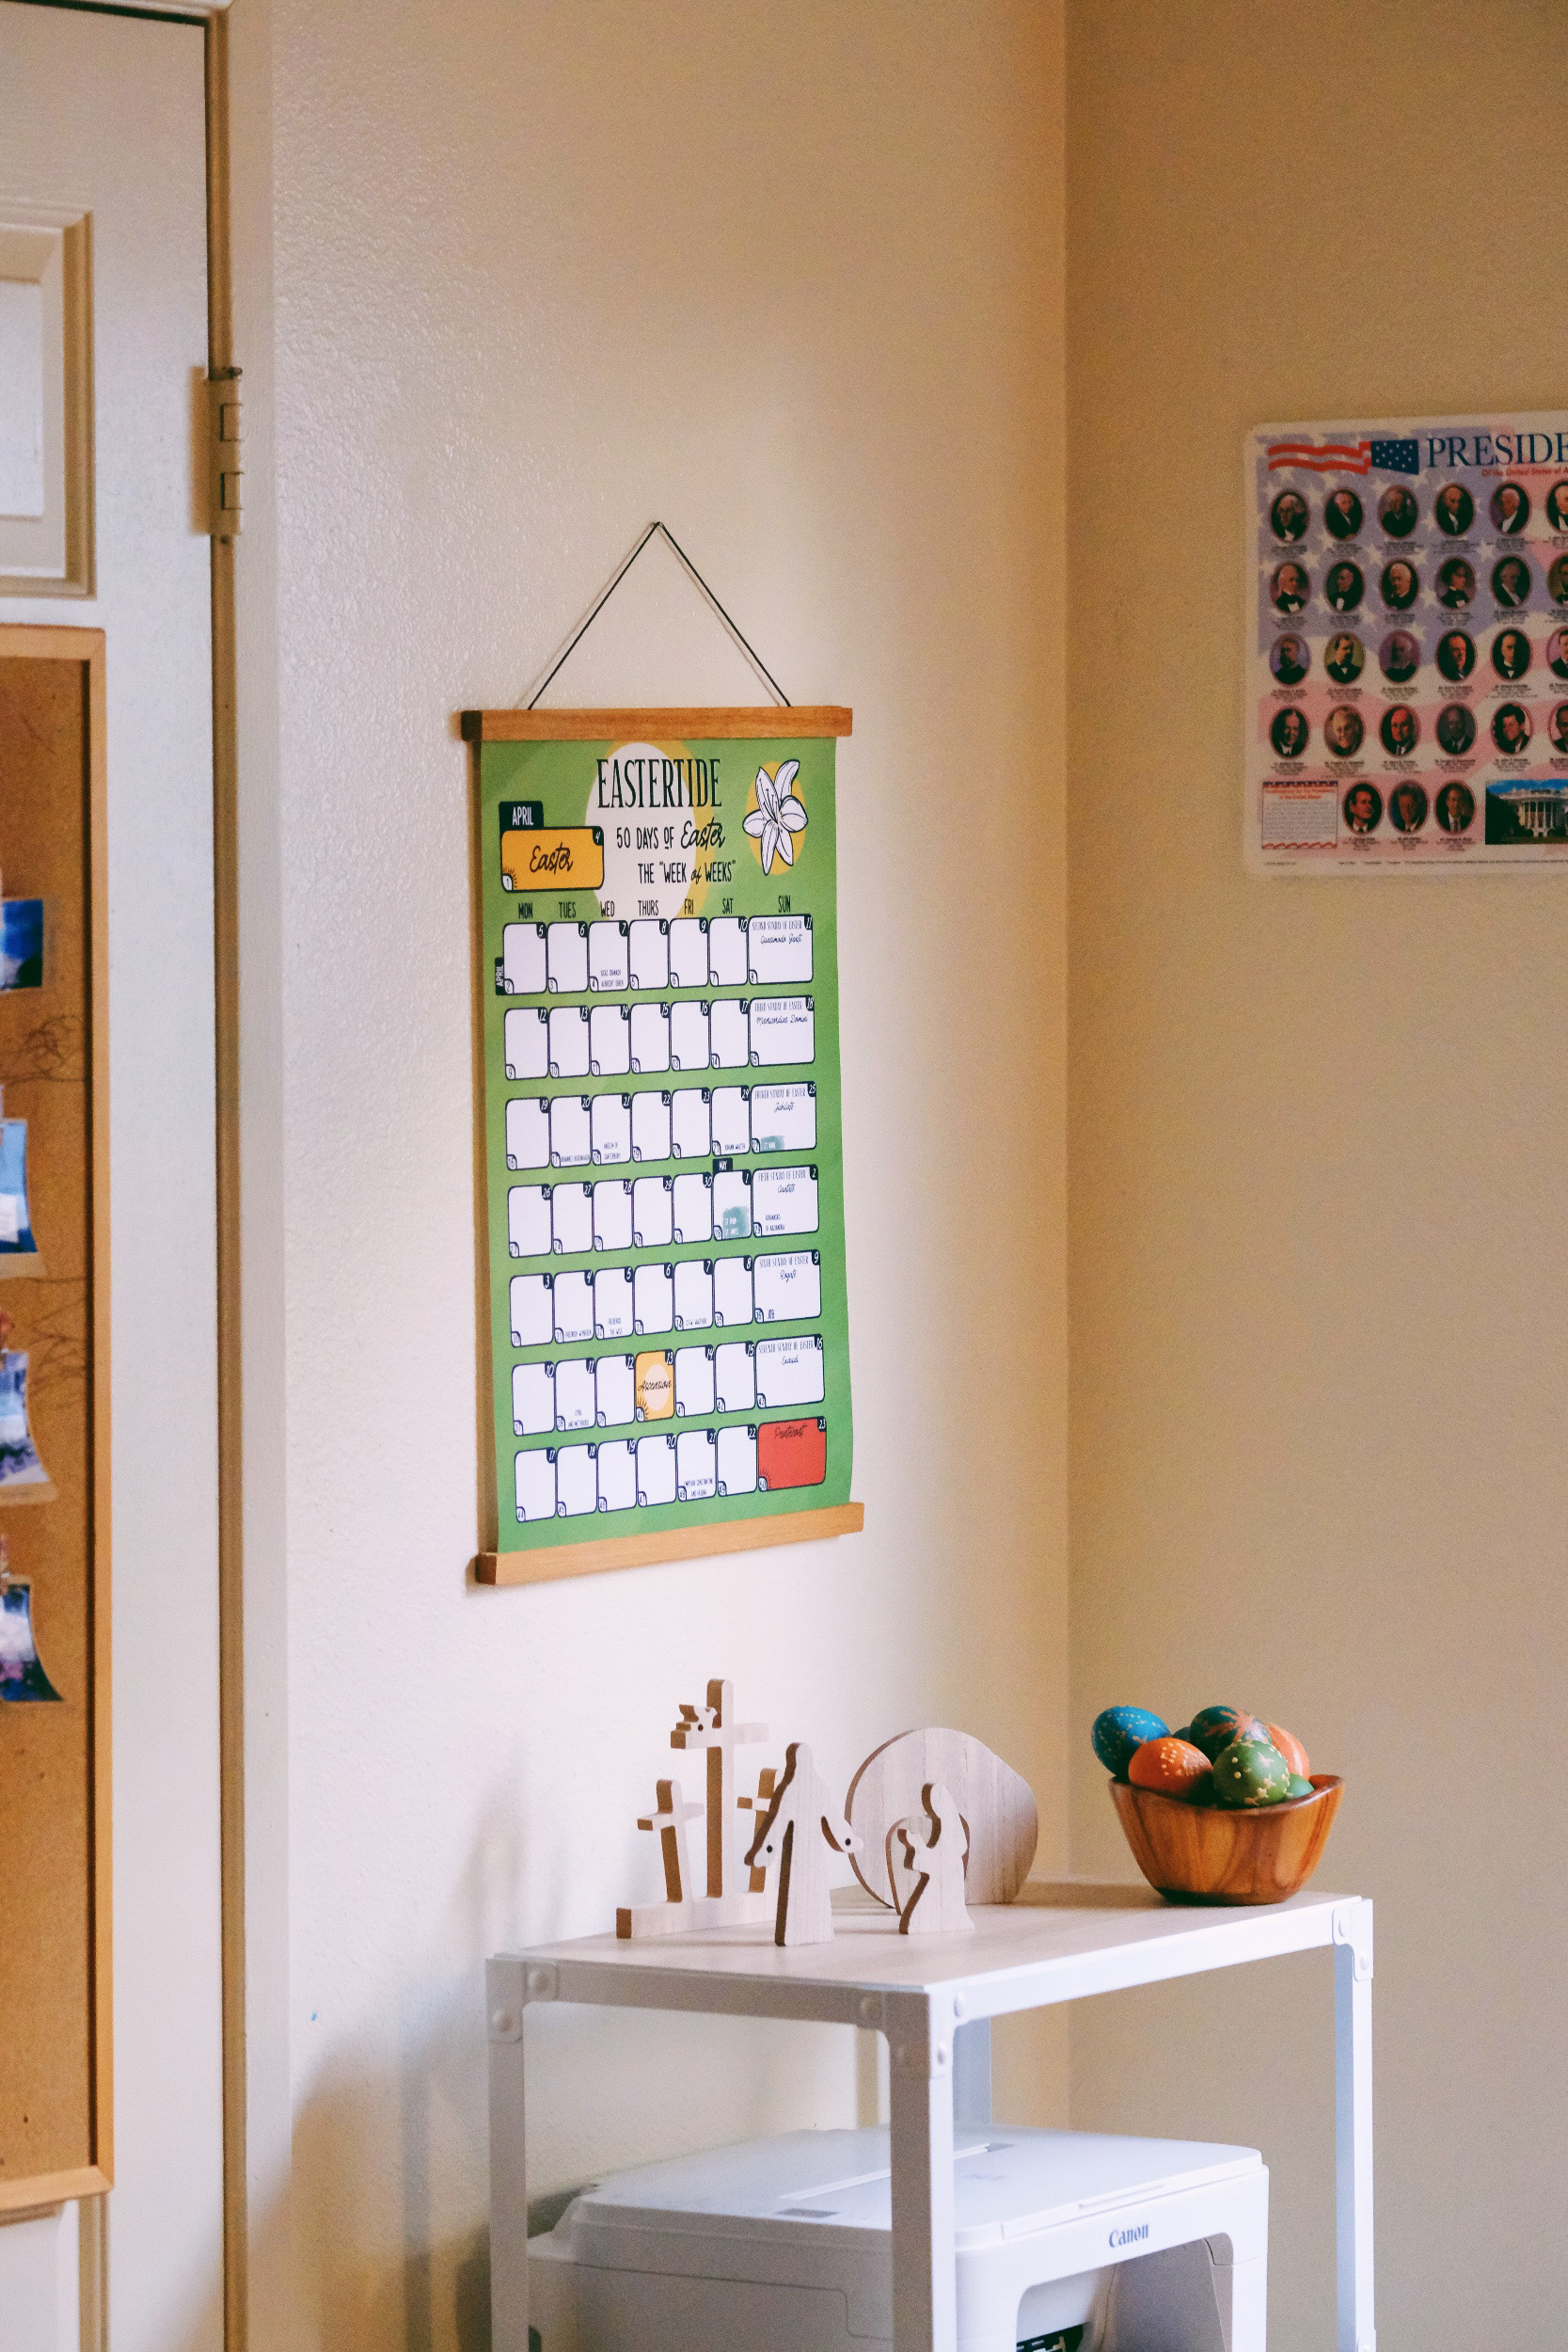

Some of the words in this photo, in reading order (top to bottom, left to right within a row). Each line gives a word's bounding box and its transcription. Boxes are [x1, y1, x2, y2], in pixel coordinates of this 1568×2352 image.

[596, 758, 722, 808] EASTERTIDE
[512, 806, 534, 826] APRIL
[595, 832, 600, 842] 4
[616, 826, 631, 849] 50
[636, 826, 659, 850] DAYS
[680, 817, 726, 851] Easter
[529, 842, 574, 875] Easter
[638, 863, 655, 883] THE
[690, 866, 703, 885] of
[517, 902, 533, 919] MON
[559, 901, 577, 918] TUES
[599, 900, 615, 917] WED
[638, 899, 659, 916] THURS
[684, 898, 694, 914] FRI
[722, 898, 734, 914] SAT
[778, 896, 791, 913] SUN
[622, 923, 626, 934] 7
[661, 921, 666, 933] 8
[702, 920, 705, 932] 9
[740, 918, 747, 931] 10
[806, 917, 813, 930] 11
[539, 925, 543, 937] 5
[580, 924, 584, 936] 6
[702, 1001, 707, 1014] 16
[741, 1001, 748, 1012] 17
[807, 997, 814, 1009] 18
[540, 1009, 546, 1022] 12
[581, 1008, 588, 1020] 13
[621, 1005, 628, 1018] 14
[662, 1004, 668, 1016] 15
[742, 1087, 749, 1099] 24
[809, 1084, 816, 1094] 25
[624, 1094, 630, 1106] 21
[663, 1093, 670, 1104] 22
[704, 1090, 709, 1102] 23
[542, 1100, 547, 1110] 19
[582, 1097, 590, 1108] 20
[719, 1160, 728, 1171] MAY
[745, 1173, 749, 1183] 1
[812, 1168, 816, 1177] 2
[624, 1180, 632, 1192] 28
[665, 1179, 672, 1190] 29
[705, 1176, 712, 1187] 30
[543, 1186, 550, 1198] 26
[584, 1184, 591, 1196] 27
[747, 1257, 752, 1268] 8
[815, 1252, 818, 1263] 9
[626, 1267, 631, 1279] 5
[666, 1264, 671, 1276] 6
[706, 1261, 710, 1273] 7
[546, 1276, 549, 1288] 3
[587, 1271, 592, 1283] 4
[816, 1338, 822, 1349] 16
[707, 1348, 714, 1359] 14
[748, 1344, 753, 1356] 15
[627, 1357, 633, 1368] 12
[667, 1352, 673, 1364] 13
[546, 1364, 554, 1376] 10
[588, 1360, 594, 1372] 11
[819, 1420, 825, 1429] 23
[710, 1433, 716, 1442] 21
[749, 1427, 755, 1438] 22
[629, 1440, 635, 1452] 19
[668, 1436, 675, 1447] 20
[549, 1450, 555, 1461] 17
[590, 1445, 595, 1456] 18
[1109, 2224, 1148, 2248] Canon
